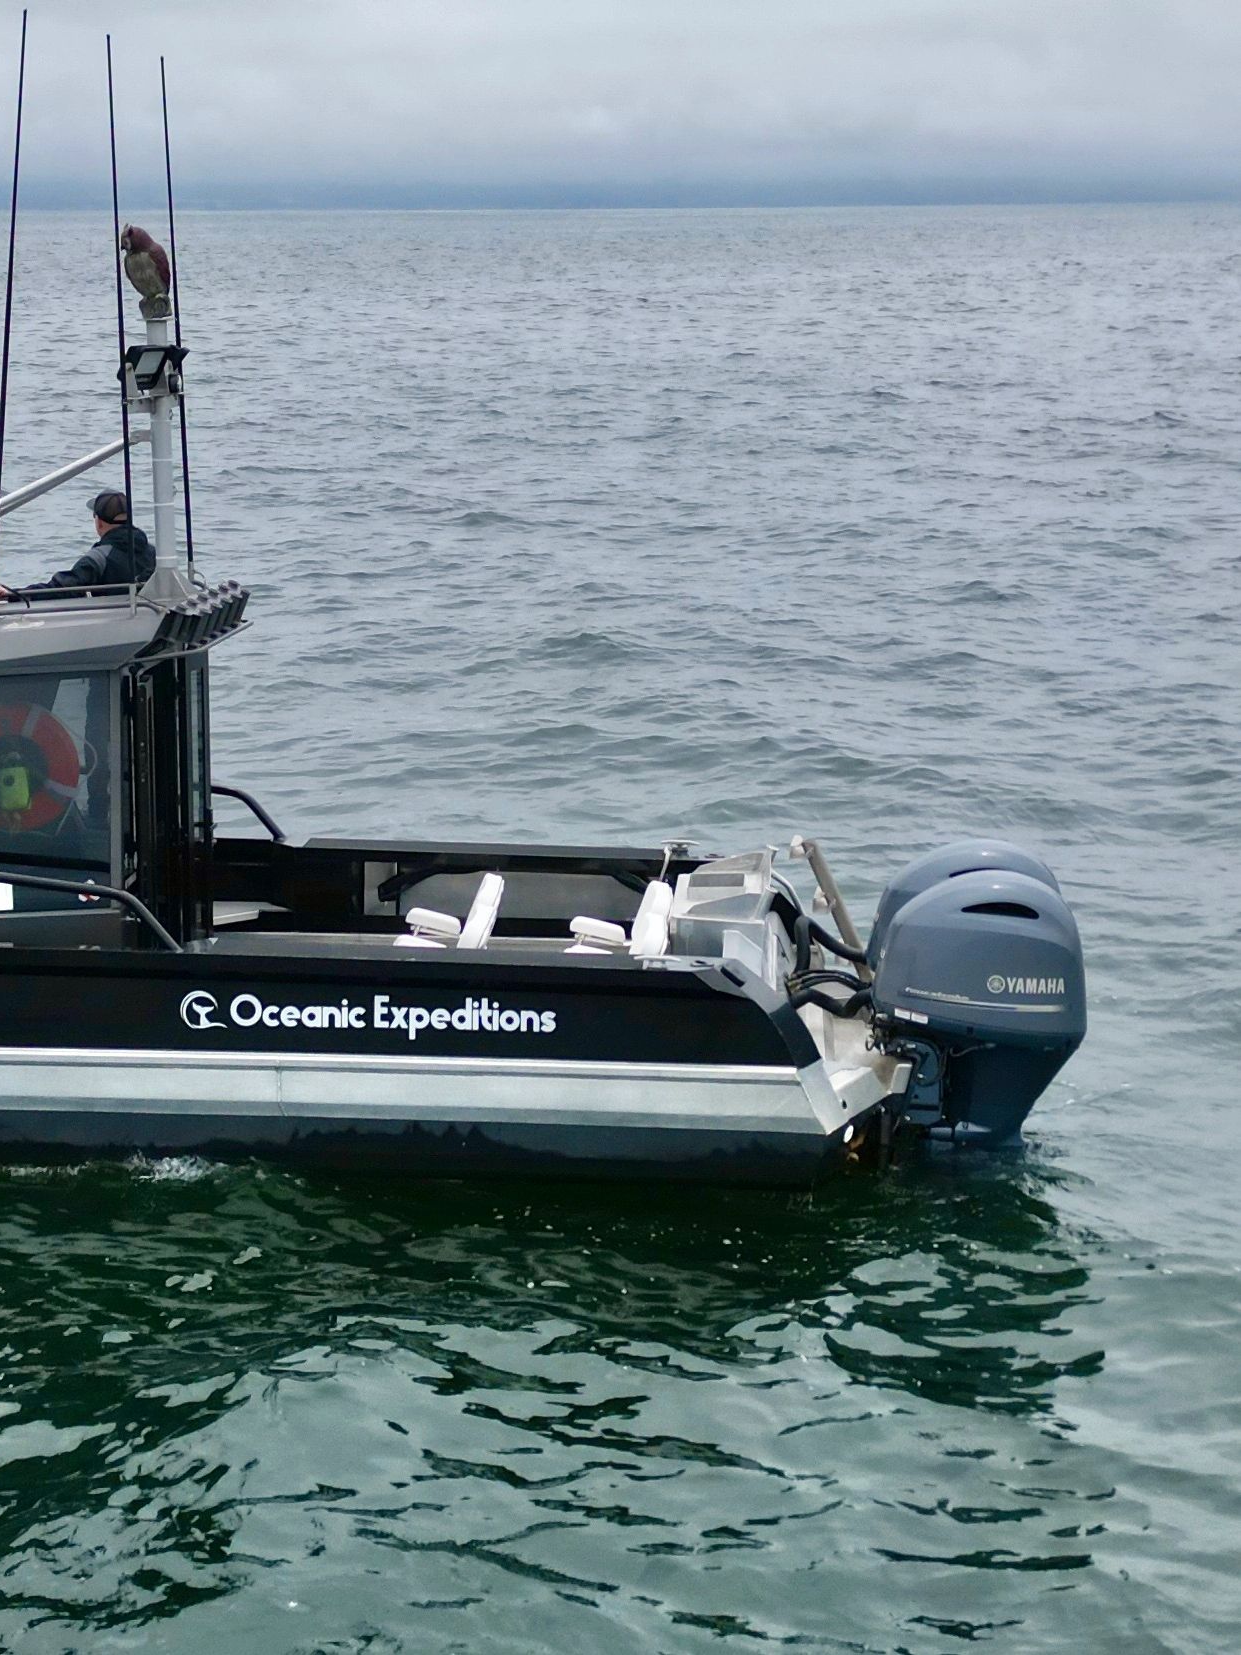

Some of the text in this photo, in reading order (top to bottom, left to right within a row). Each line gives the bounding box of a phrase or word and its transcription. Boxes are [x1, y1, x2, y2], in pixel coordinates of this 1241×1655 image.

[1006, 977, 1065, 994] YAMAHA
[229, 993, 557, 1040] Oceanic Expeditions
